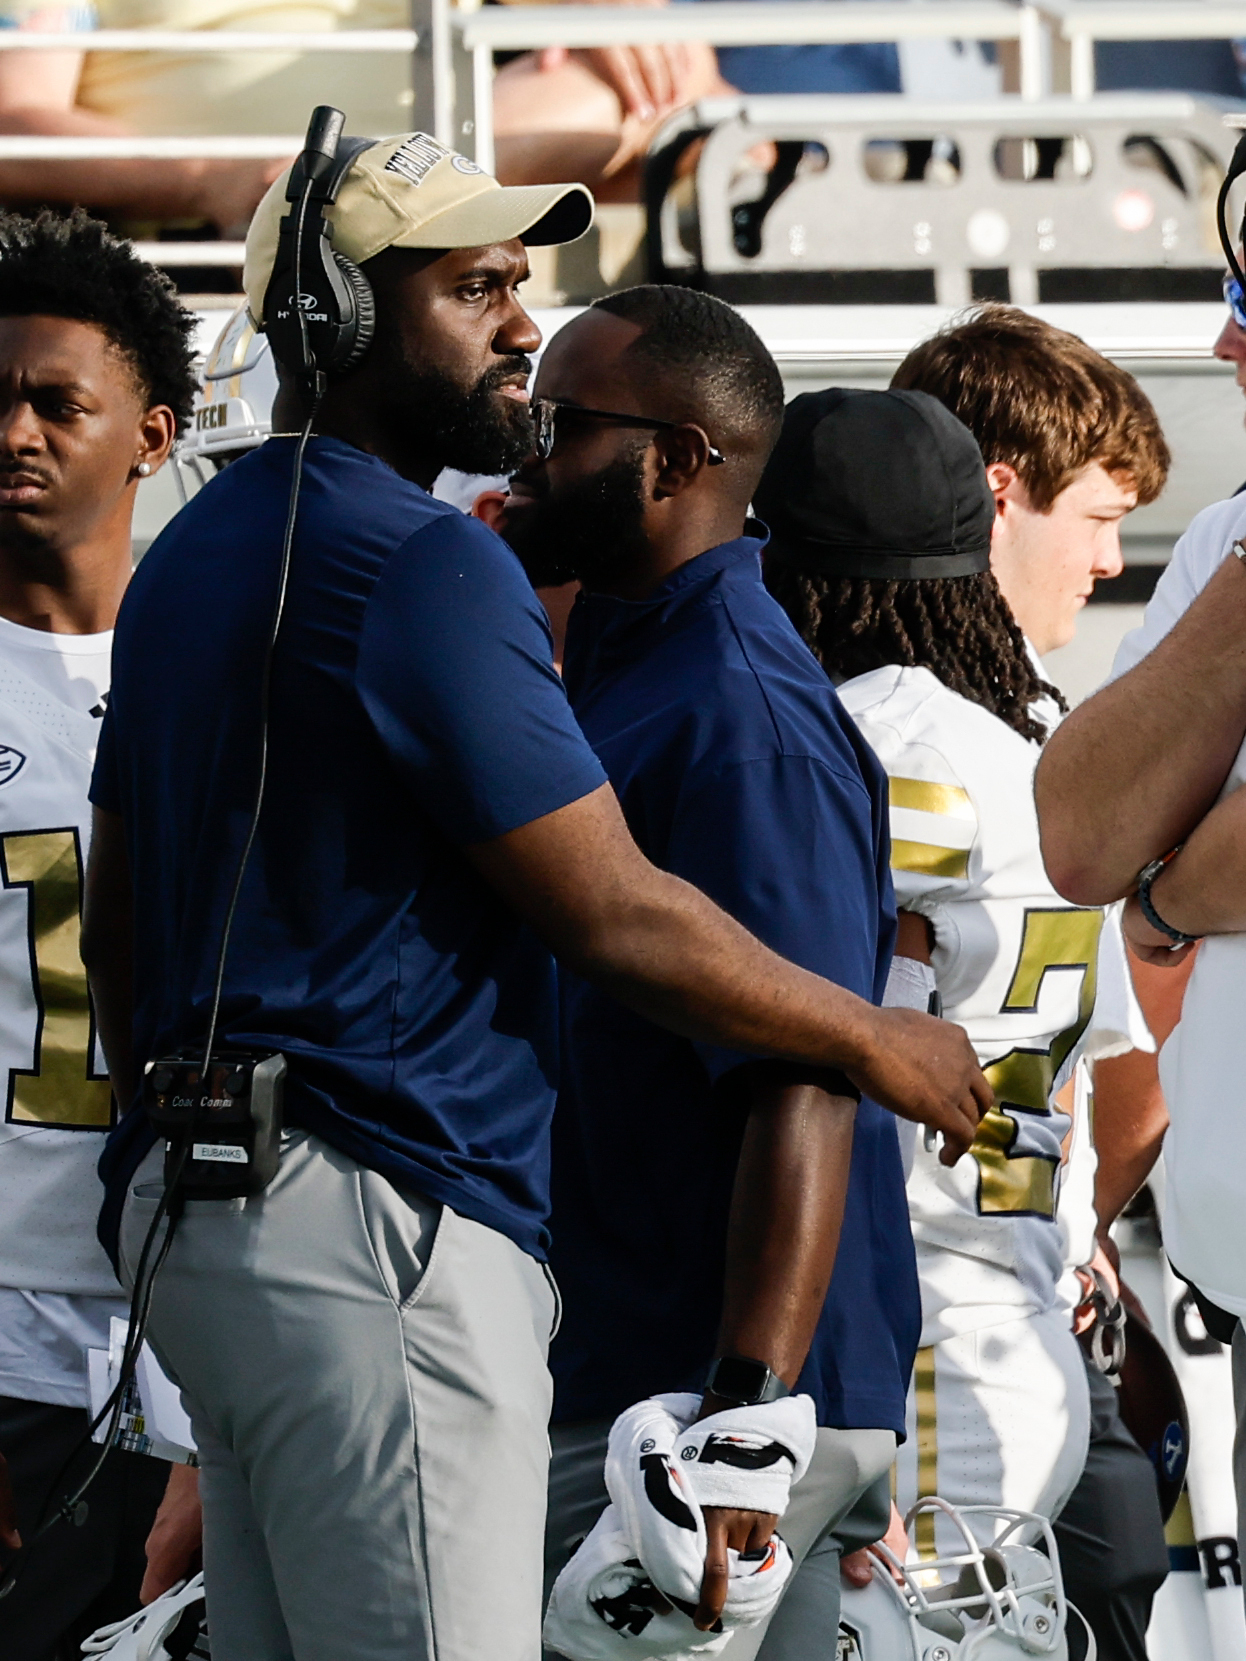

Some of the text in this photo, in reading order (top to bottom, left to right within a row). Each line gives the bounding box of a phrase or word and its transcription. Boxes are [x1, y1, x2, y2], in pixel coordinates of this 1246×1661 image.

[277, 310, 328, 322] HDAI
[0, 826, 118, 1132] 1
[201, 1147, 242, 1159] EUBANKS
